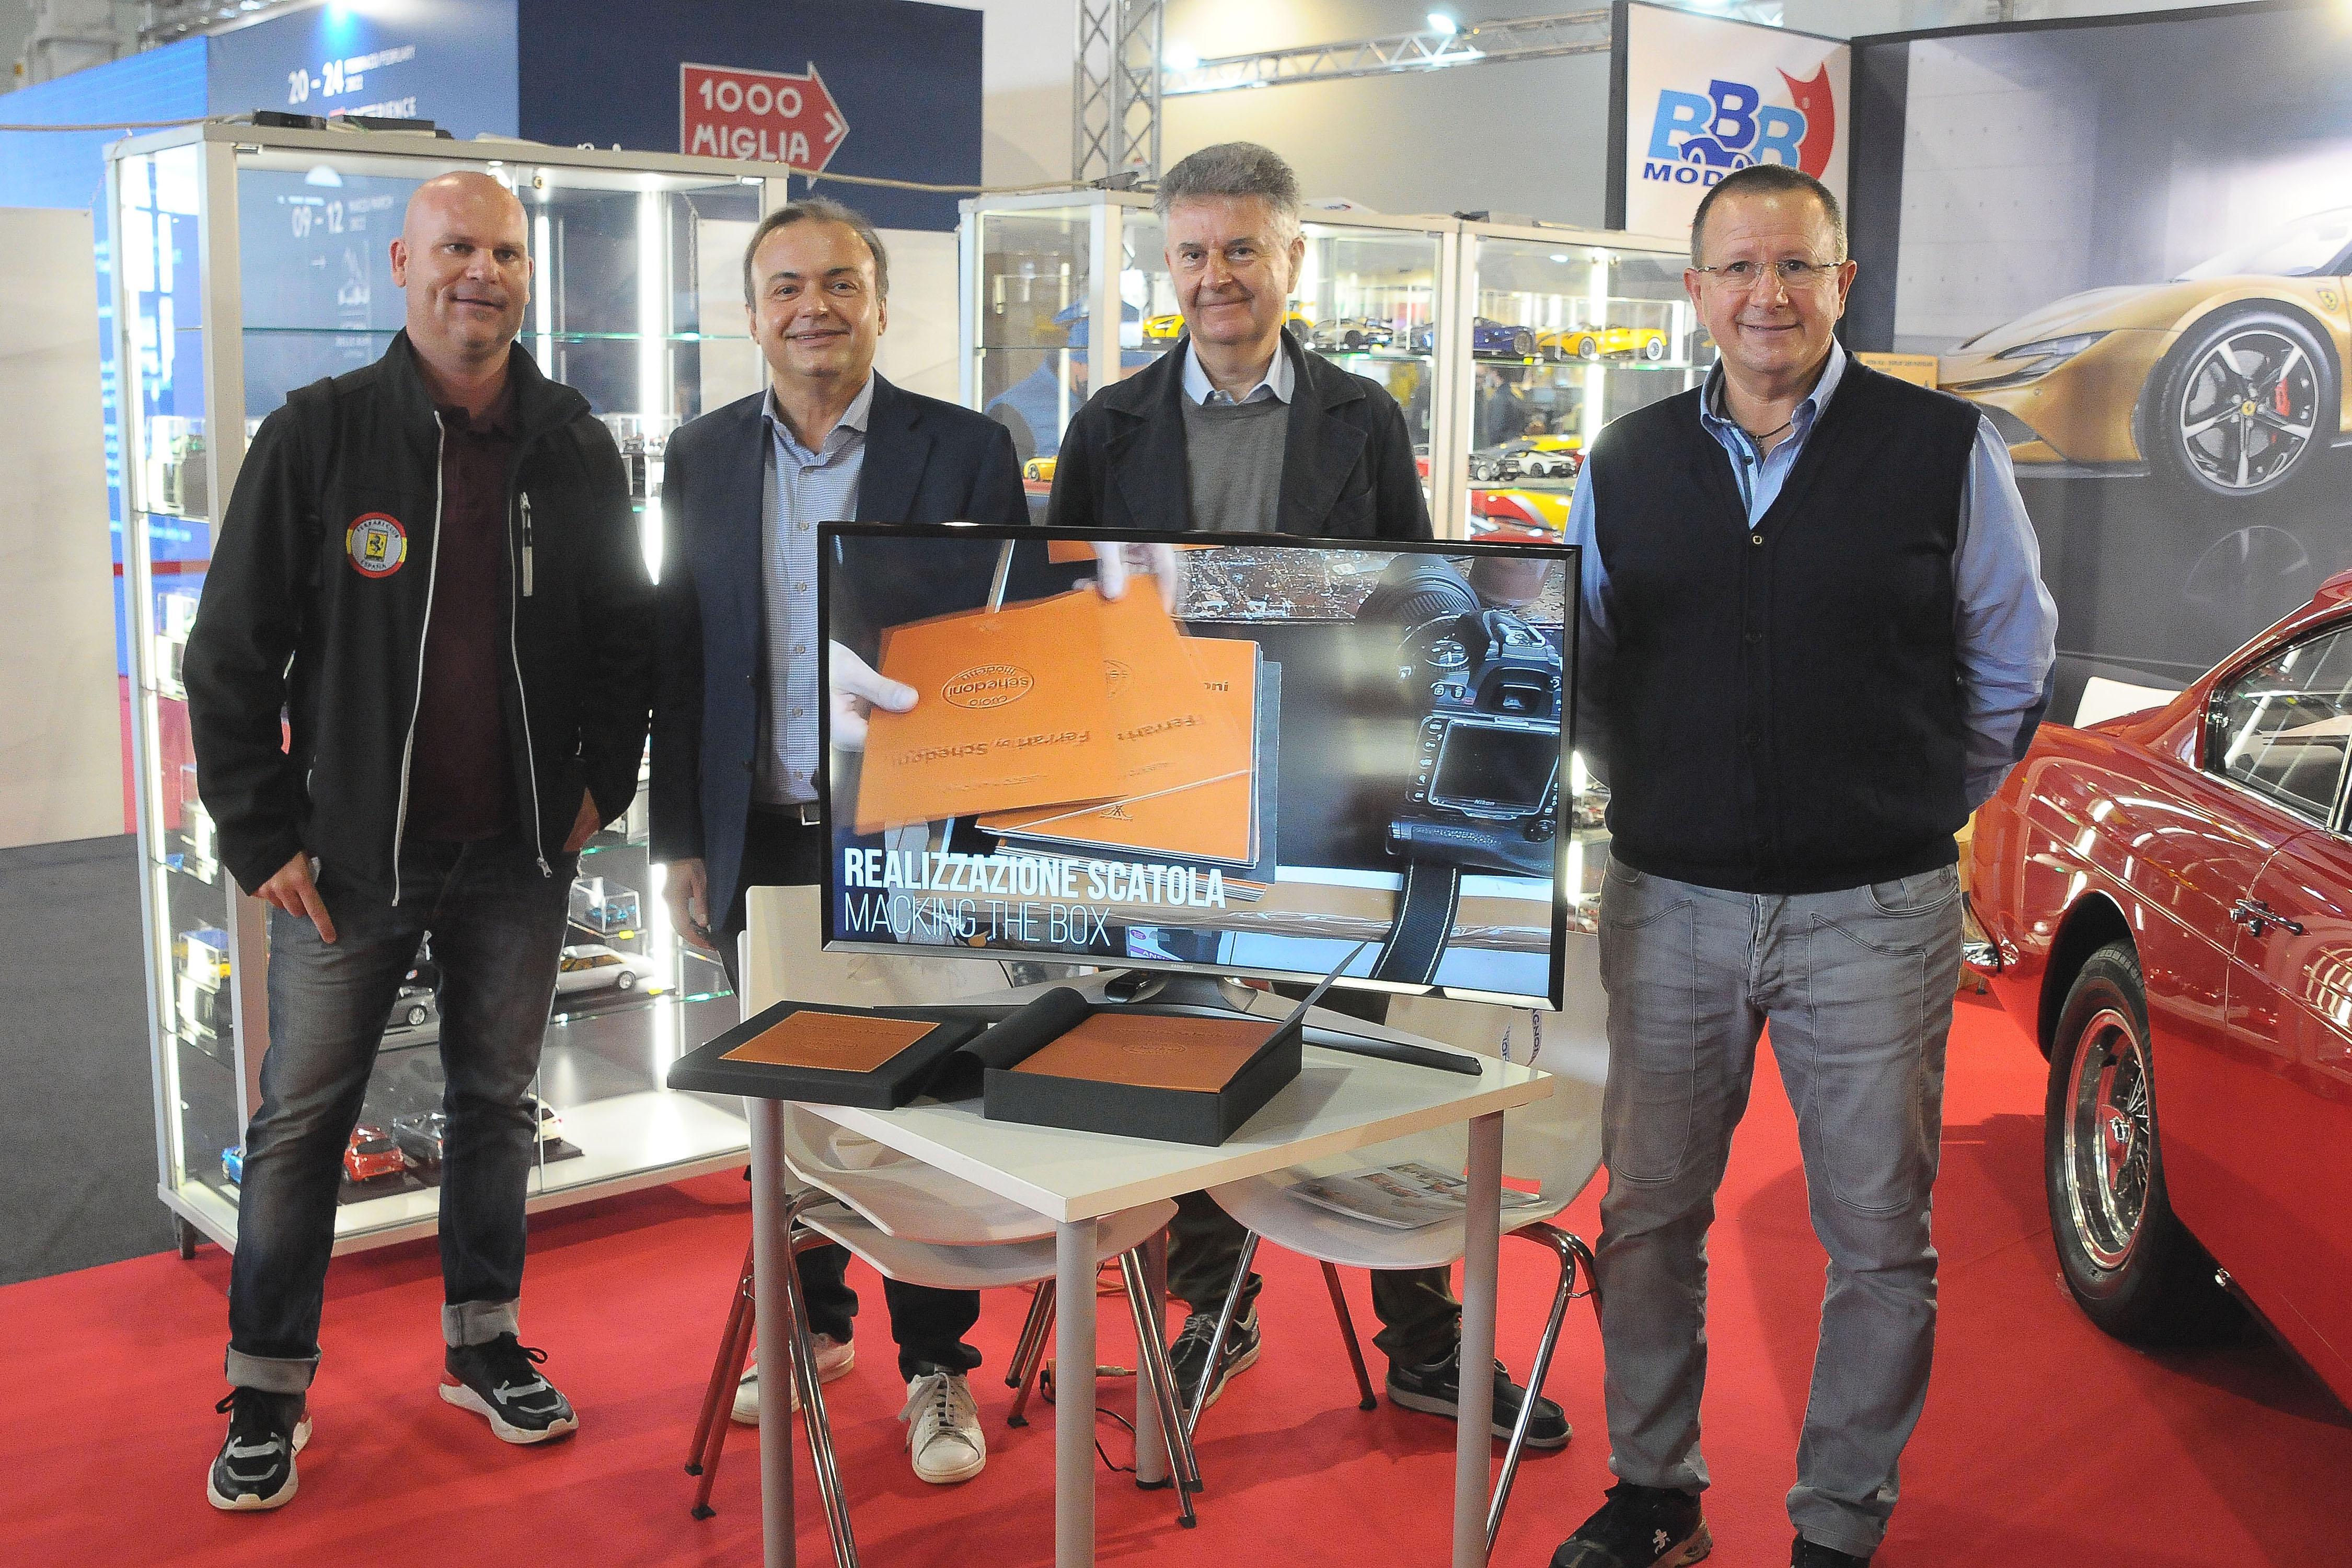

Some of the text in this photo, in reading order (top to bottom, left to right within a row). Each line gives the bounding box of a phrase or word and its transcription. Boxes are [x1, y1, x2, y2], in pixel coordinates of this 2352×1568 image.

[289, 68, 309, 105] 20
[322, 59, 344, 97] 24
[699, 78, 803, 118] 1000
[691, 123, 810, 163] MIGLIA
[1647, 79, 1806, 170] BBR
[1644, 163, 1723, 187] MOD
[292, 206, 312, 238] 09
[326, 200, 343, 234] 12
[845, 848, 1226, 909] REALIZZAZIONE SCATOLA
[845, 893, 1111, 947] MACKING THE BOX
